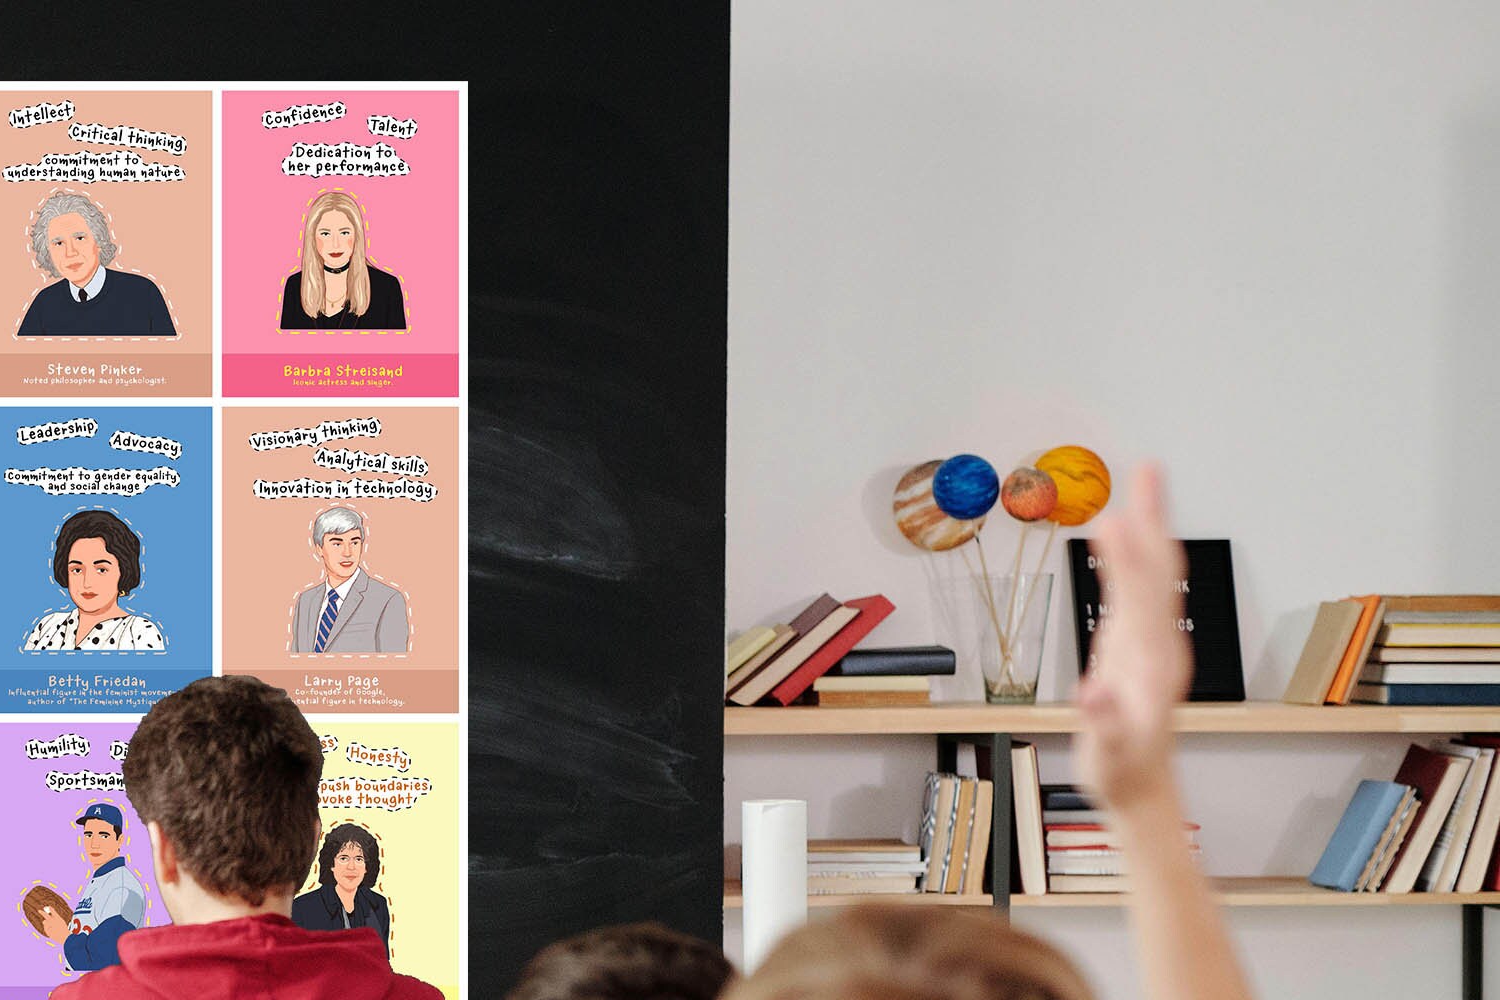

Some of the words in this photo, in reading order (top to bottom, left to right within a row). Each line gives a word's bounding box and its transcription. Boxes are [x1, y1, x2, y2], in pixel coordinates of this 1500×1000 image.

[12, 104, 71, 125] Intellect
[265, 105, 343, 125] Confidence
[371, 119, 414, 135] Talent
[72, 126, 123, 142] Critical
[128, 131, 182, 151] thinking
[45, 154, 120, 166] commitment
[125, 154, 139, 164] to
[295, 146, 371, 159] Dedication
[376, 146, 392, 158] to
[8, 167, 94, 179] understanding
[100, 167, 136, 178] human
[141, 167, 180, 178] nature
[288, 161, 310, 172] her
[316, 160, 404, 174] performance
[48, 363, 95, 376] Steven
[100, 363, 142, 376] Pinker
[284, 365, 330, 377] Barbra
[336, 364, 403, 378] Streisand
[21, 422, 94, 441] Leadership
[253, 432, 317, 447] Visionary
[322, 421, 377, 438] thinking
[113, 435, 178, 456] Advocacy
[317, 451, 386, 470] Analytical
[391, 459, 425, 473] skills
[8, 471, 74, 481] Commitment
[78, 471, 90, 480] to
[95, 471, 131, 483] gender
[135, 470, 177, 483] equality
[48, 483, 66, 491] and
[104, 482, 140, 492] change
[259, 482, 332, 494] Innovation
[338, 483, 349, 494] in
[354, 481, 432, 497] technology
[48, 675, 89, 691] Betty
[94, 675, 146, 688] Friedan
[305, 675, 342, 690] Larry
[348, 675, 379, 690] Page
[29, 738, 86, 755] Humility
[350, 747, 407, 768] Honesty
[321, 781, 350, 793] push
[356, 781, 428, 793] boundaries
[358, 793, 412, 808] thought
